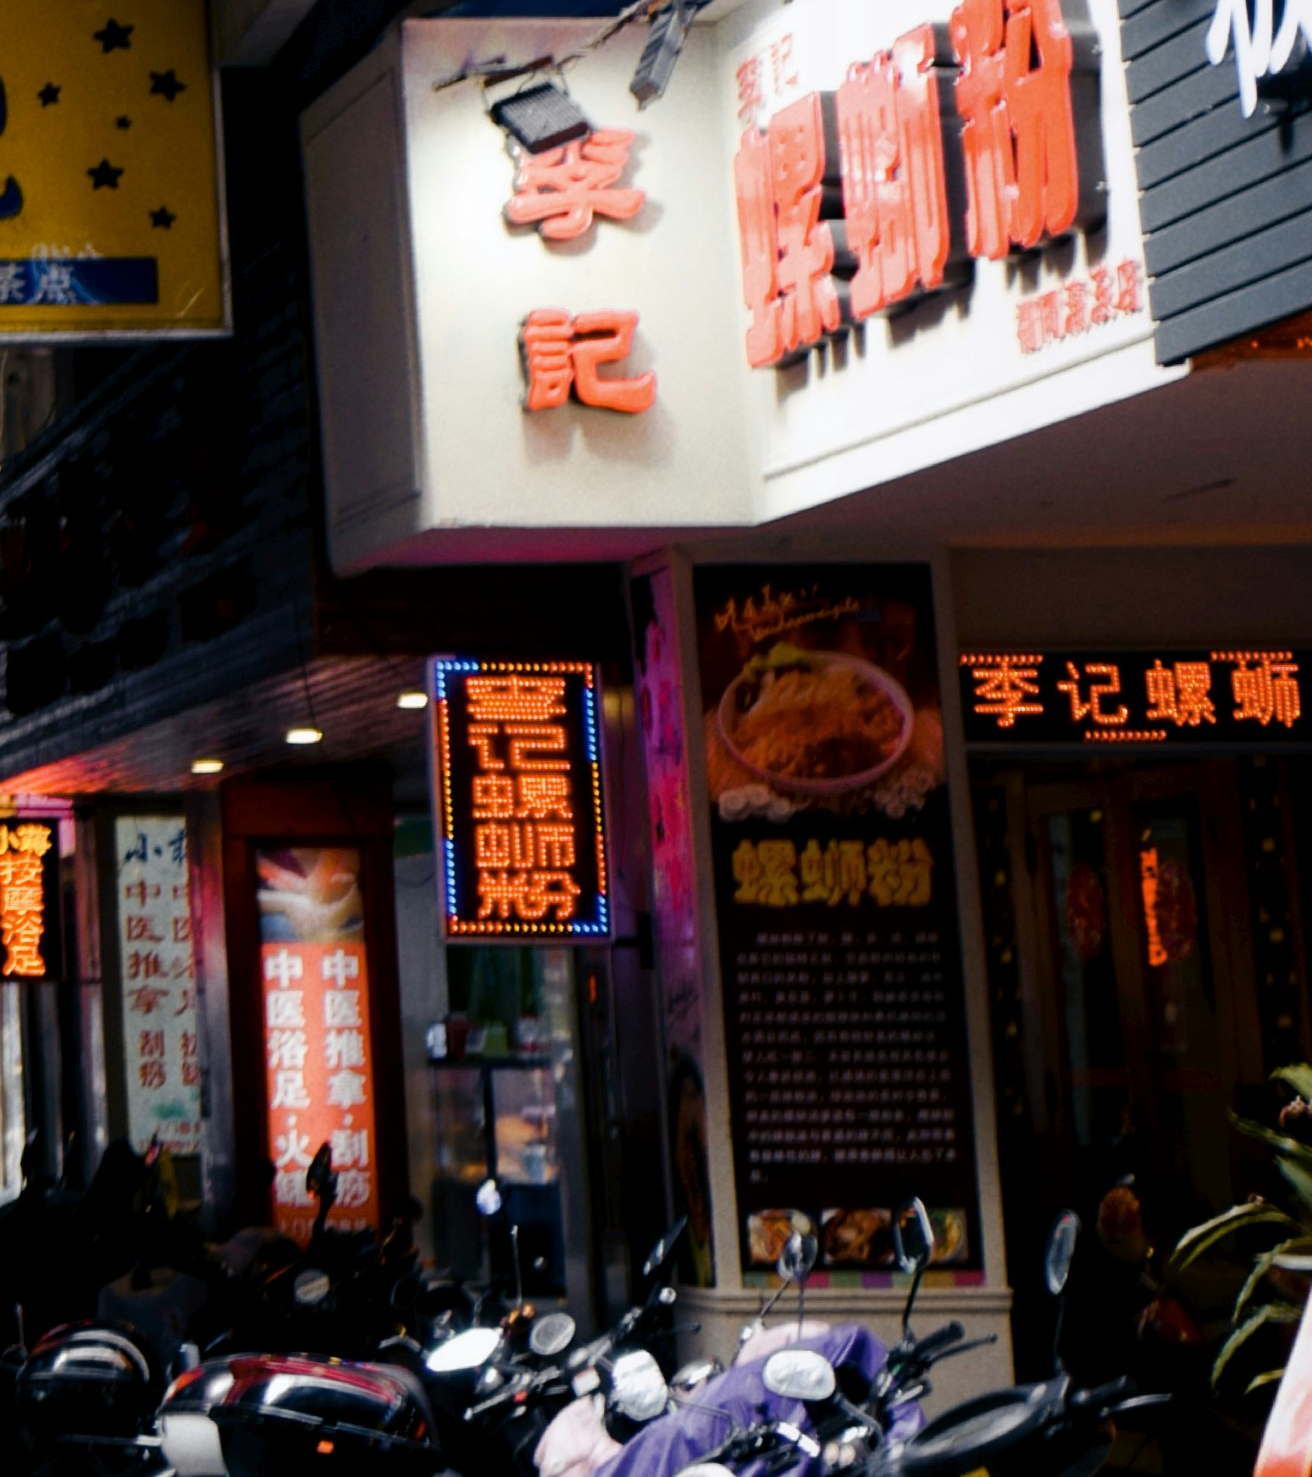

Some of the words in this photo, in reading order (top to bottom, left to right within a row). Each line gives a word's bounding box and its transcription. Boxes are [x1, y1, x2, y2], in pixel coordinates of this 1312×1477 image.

[972, 658, 1303, 729] 李记螺蛳
[467, 674, 583, 921] 李记螺蛳粉
